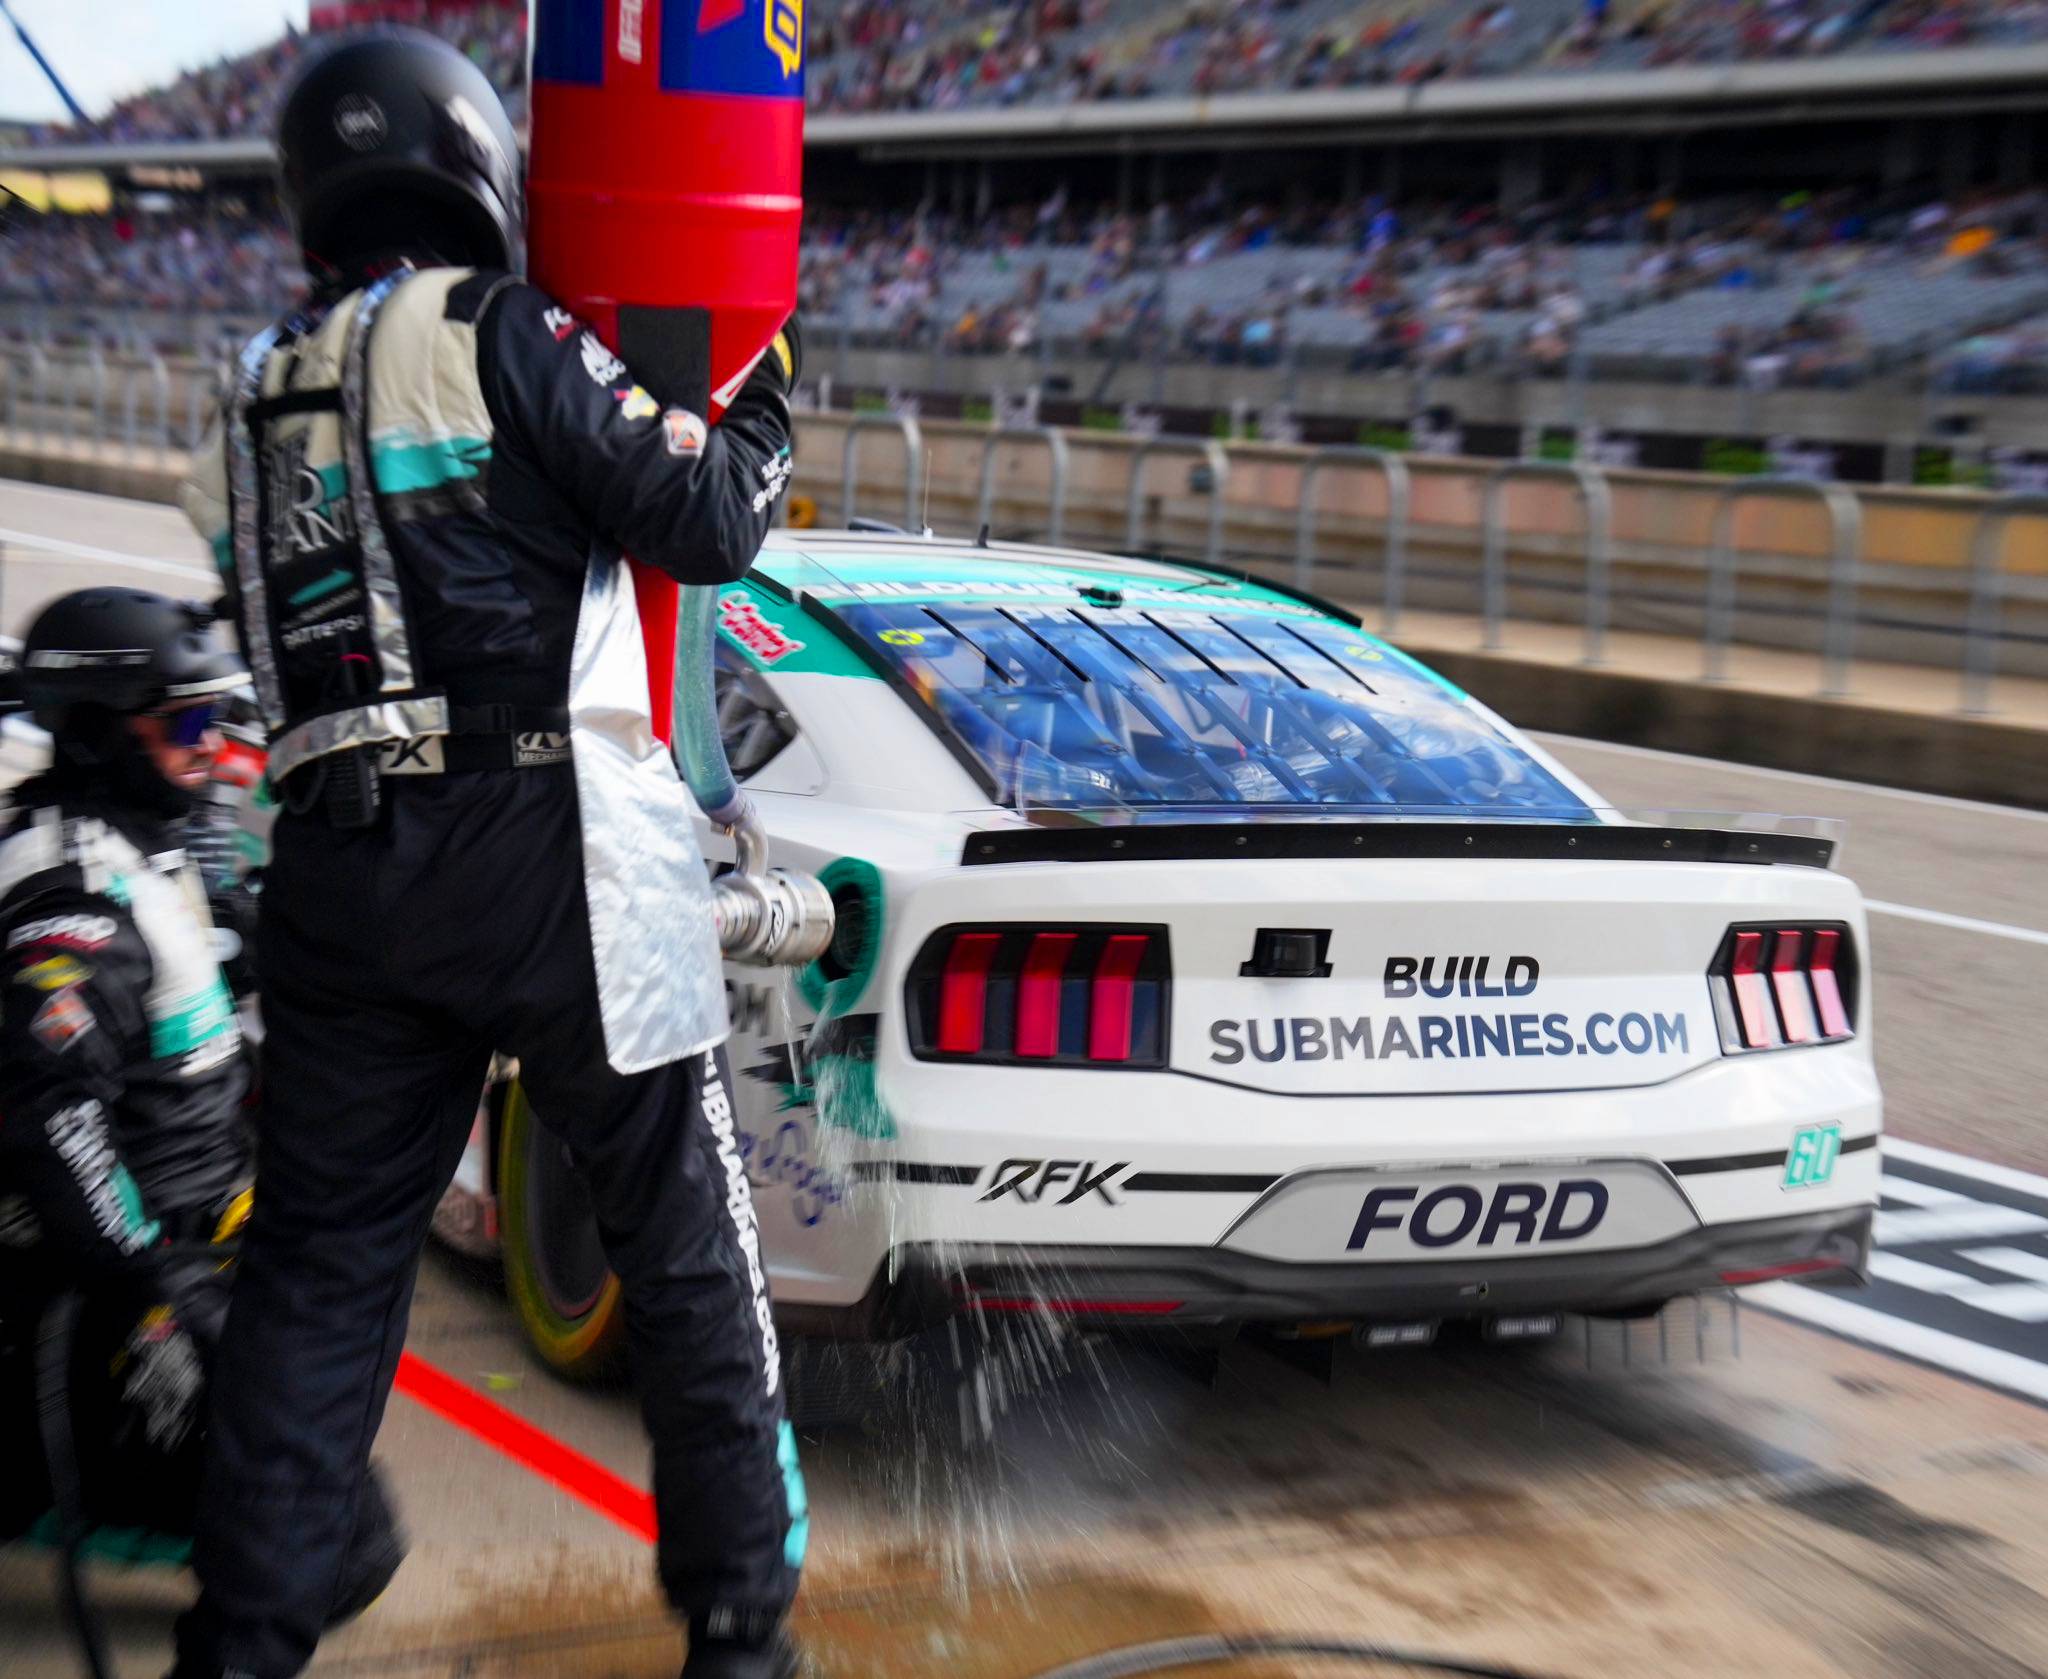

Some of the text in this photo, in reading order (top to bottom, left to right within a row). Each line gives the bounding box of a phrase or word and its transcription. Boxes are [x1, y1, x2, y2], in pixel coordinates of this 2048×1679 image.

[1384, 955, 1541, 998] BUILD
[1208, 1012, 1690, 1064] SUBMARINES.COM
[1782, 1121, 1842, 1189] 60
[976, 1158, 1130, 1206] RFK
[1345, 1178, 1609, 1252] FORD
